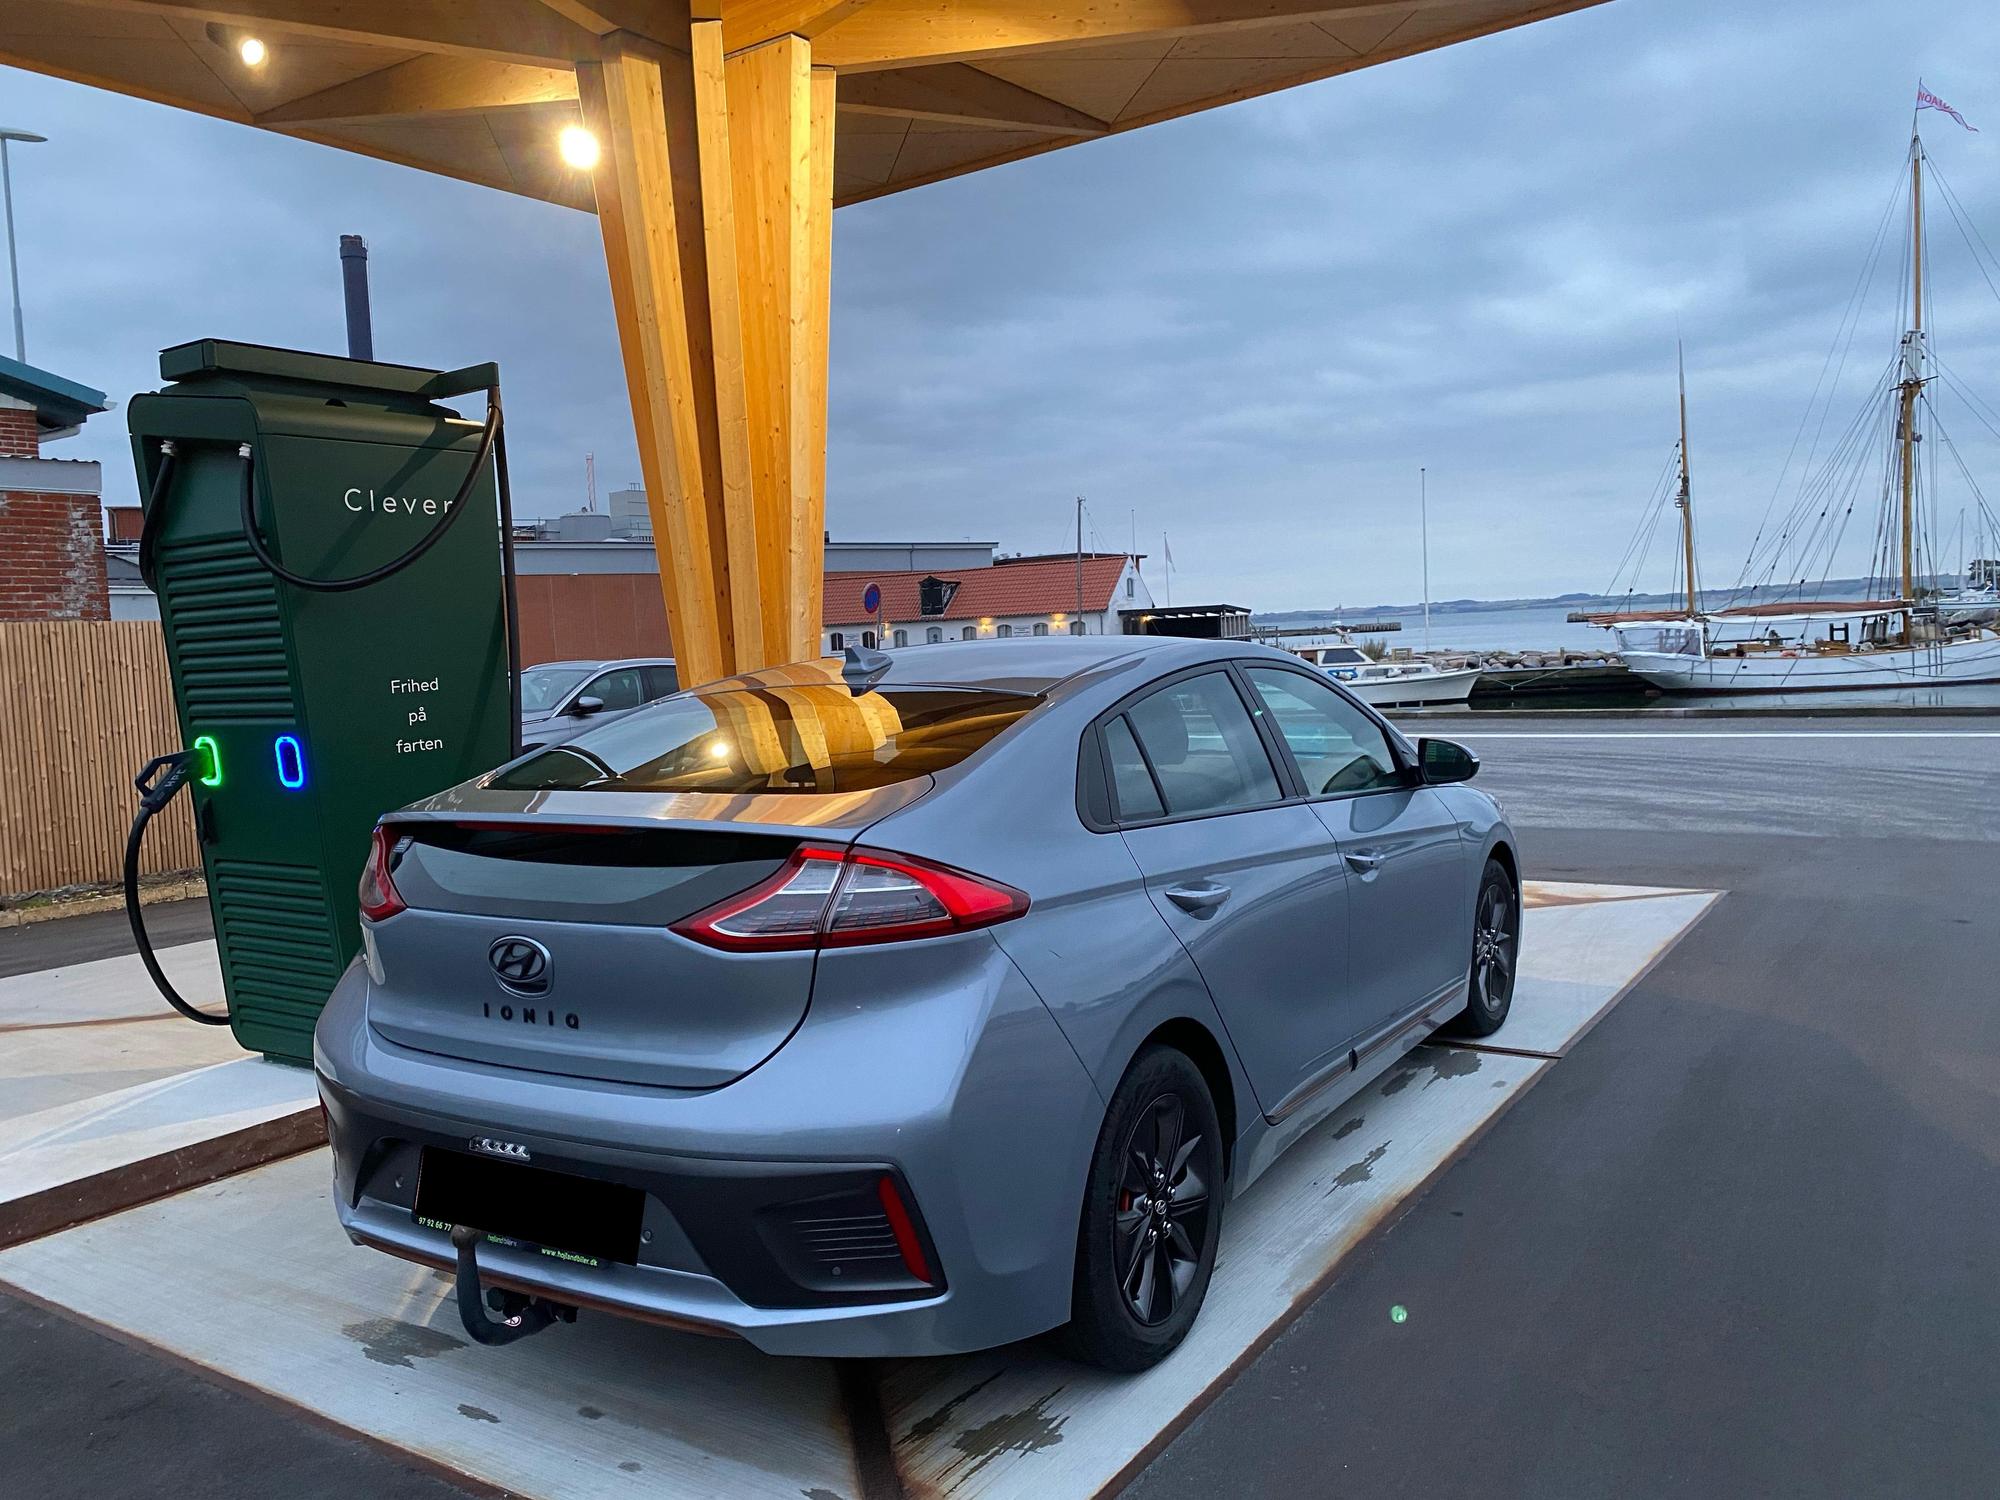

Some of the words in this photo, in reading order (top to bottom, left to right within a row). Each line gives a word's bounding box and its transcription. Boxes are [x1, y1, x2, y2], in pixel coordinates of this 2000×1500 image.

[344, 488, 453, 515] Clever
[390, 677, 439, 694] Frihed
[408, 706, 427, 726] på
[395, 738, 443, 754] farten
[164, 768, 187, 787] HPC
[483, 1002, 580, 1029] IONIQ
[418, 1217, 427, 1225] 97
[426, 1219, 434, 1227] 92
[435, 1221, 443, 1229] 66
[444, 1222, 452, 1231] 77
